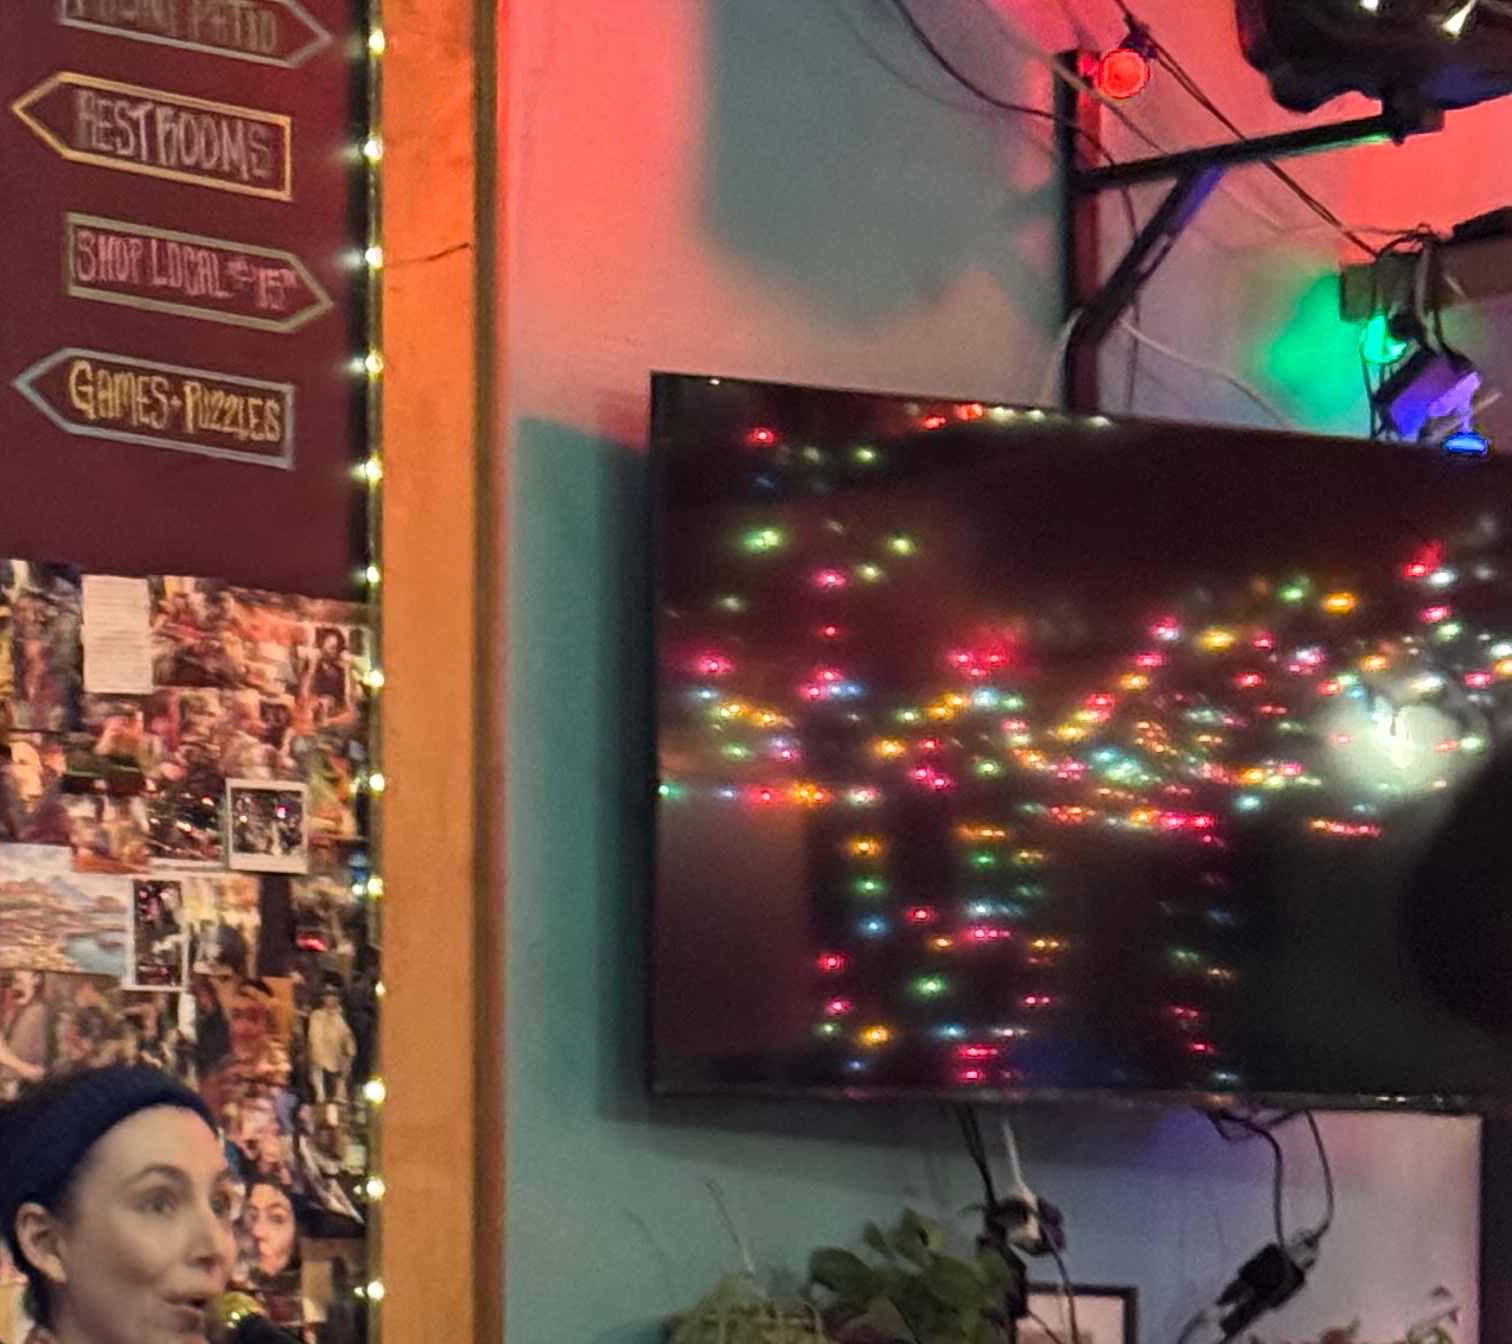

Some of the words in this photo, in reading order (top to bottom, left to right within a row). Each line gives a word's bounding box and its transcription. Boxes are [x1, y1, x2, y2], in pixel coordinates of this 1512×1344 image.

[75, 90, 273, 180] RESTROOMS
[76, 229, 143, 284] SHOP
[151, 239, 233, 299] LOCAL
